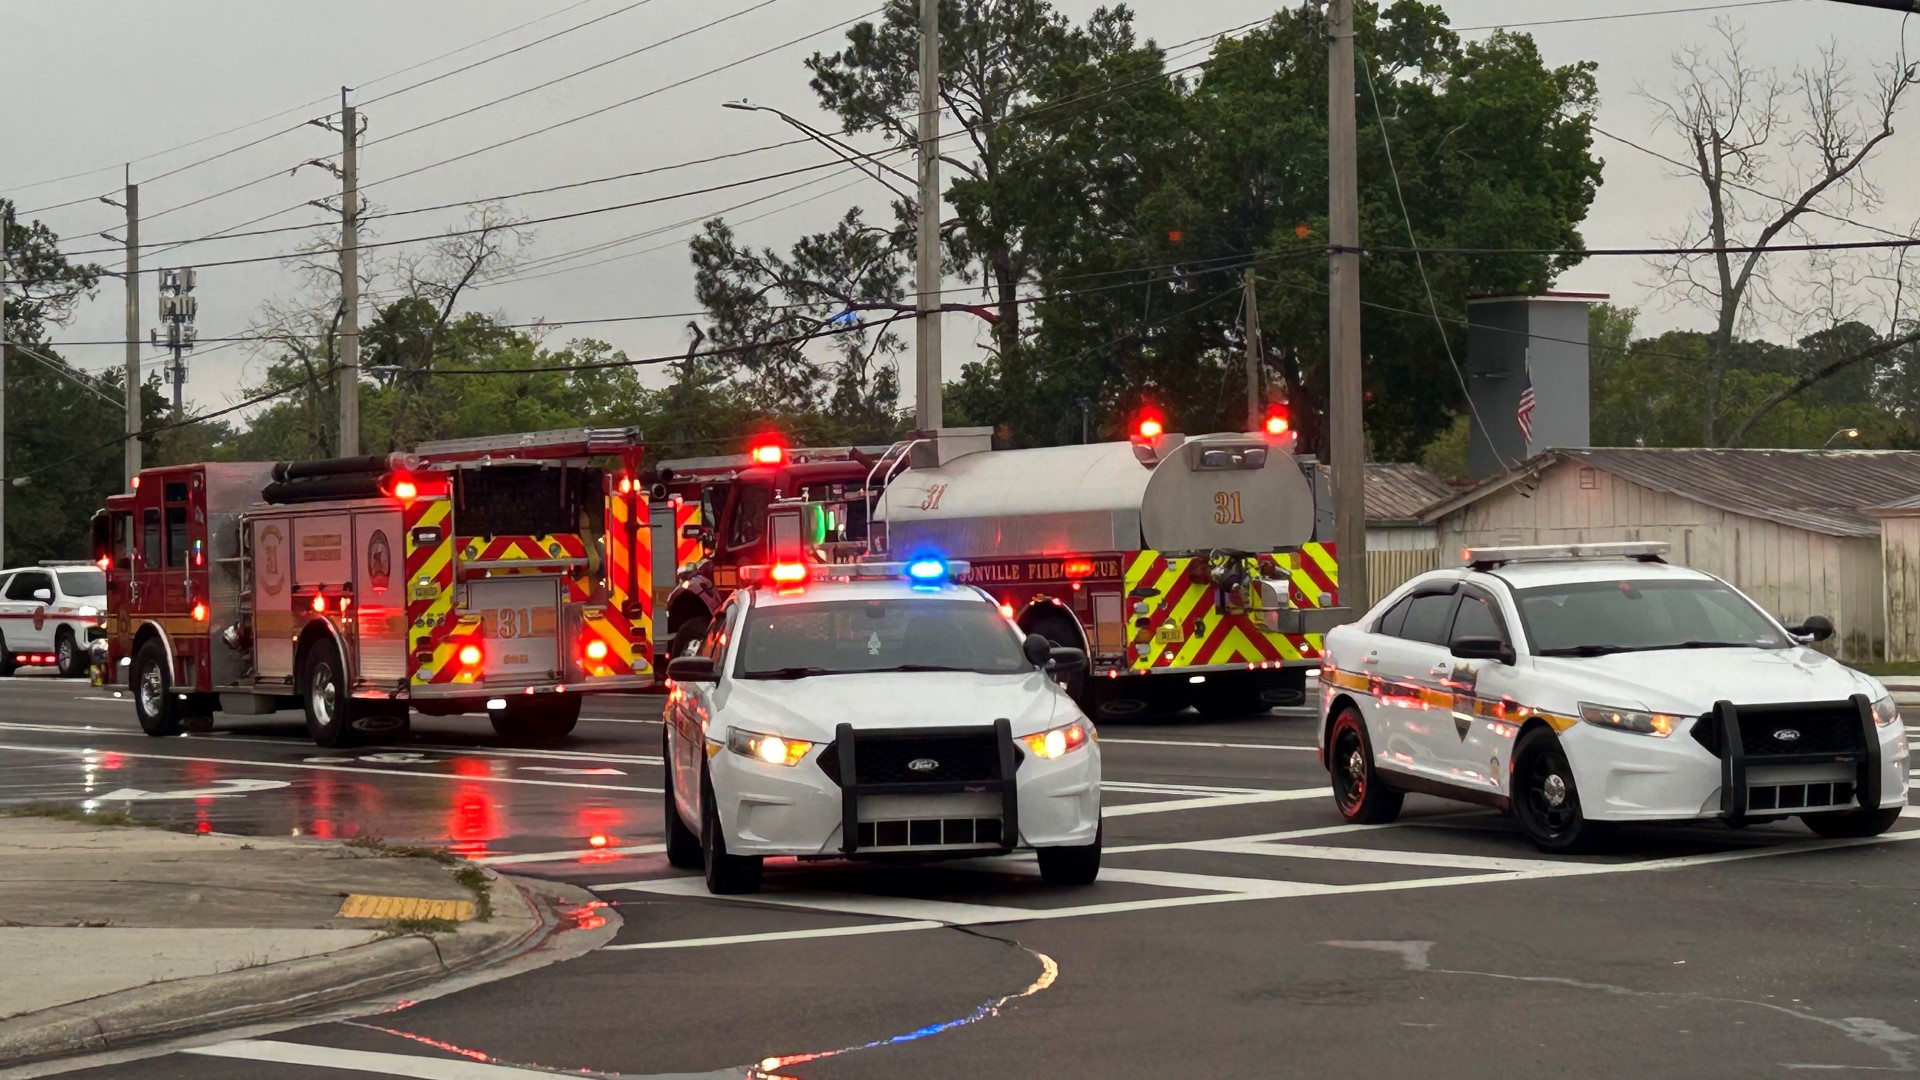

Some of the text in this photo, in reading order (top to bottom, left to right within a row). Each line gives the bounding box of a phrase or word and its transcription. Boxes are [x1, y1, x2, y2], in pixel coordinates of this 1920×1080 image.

[921, 483, 948, 510] 31
[1214, 491, 1245, 524] 31
[959, 560, 1118, 582] SONVILLE FIRE/CUE
[499, 608, 530, 638] 31
